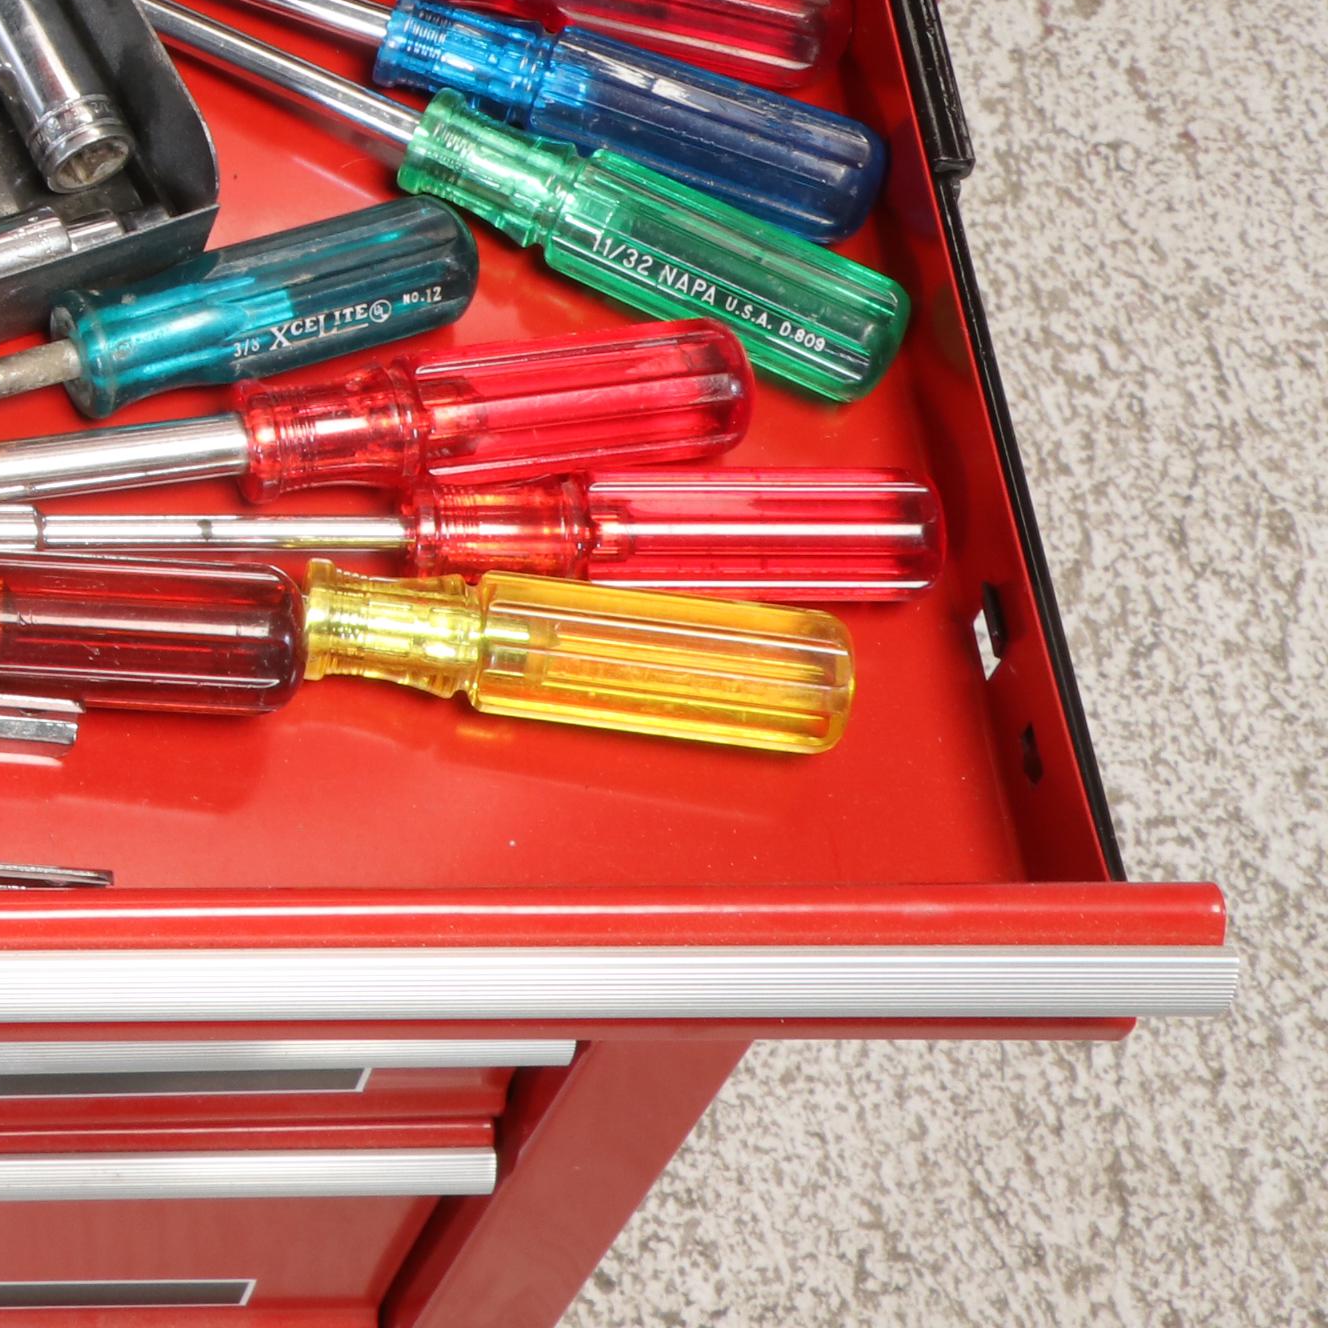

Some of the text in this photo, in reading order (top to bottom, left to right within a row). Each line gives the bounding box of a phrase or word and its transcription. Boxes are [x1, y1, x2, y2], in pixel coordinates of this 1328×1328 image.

[592, 232, 826, 352] 11/32 NAPA U.S.A. D.809
